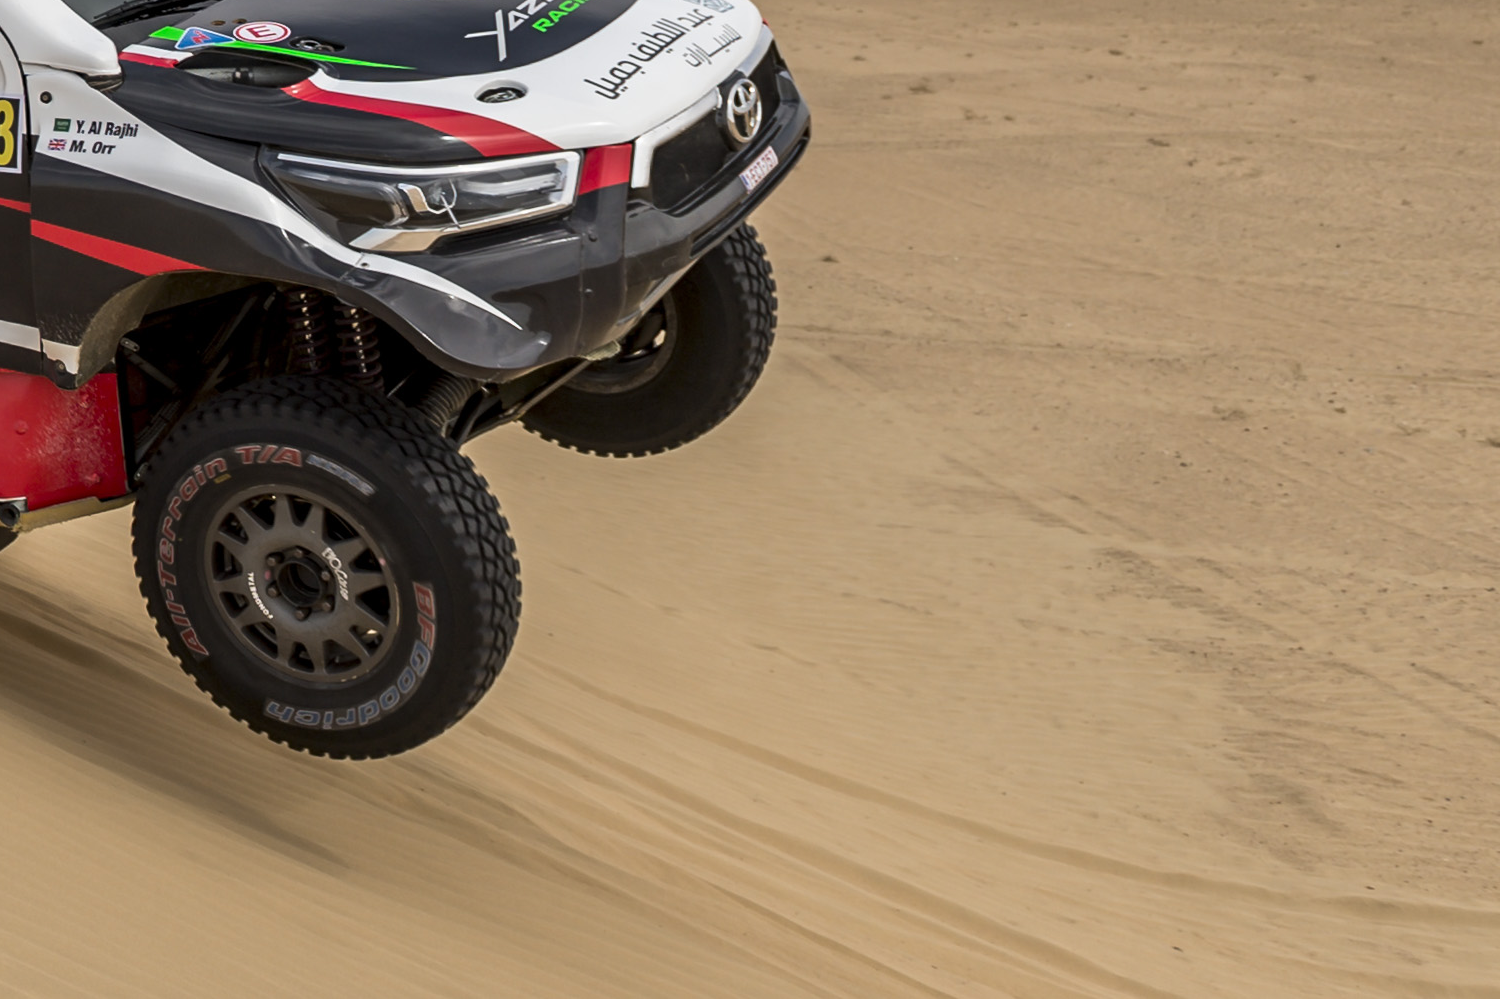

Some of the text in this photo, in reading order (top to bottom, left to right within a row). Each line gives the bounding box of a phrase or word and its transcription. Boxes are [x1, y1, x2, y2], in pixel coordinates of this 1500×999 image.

[583, 8, 715, 100] عبد اللطيف جميل
[69, 140, 116, 154] M. Orr
[76, 120, 139, 139] Y. Al Rajhi
[157, 457, 228, 657] All-Terrain
[235, 445, 302, 468] T/A
[266, 581, 437, 730] BFGoodrich
